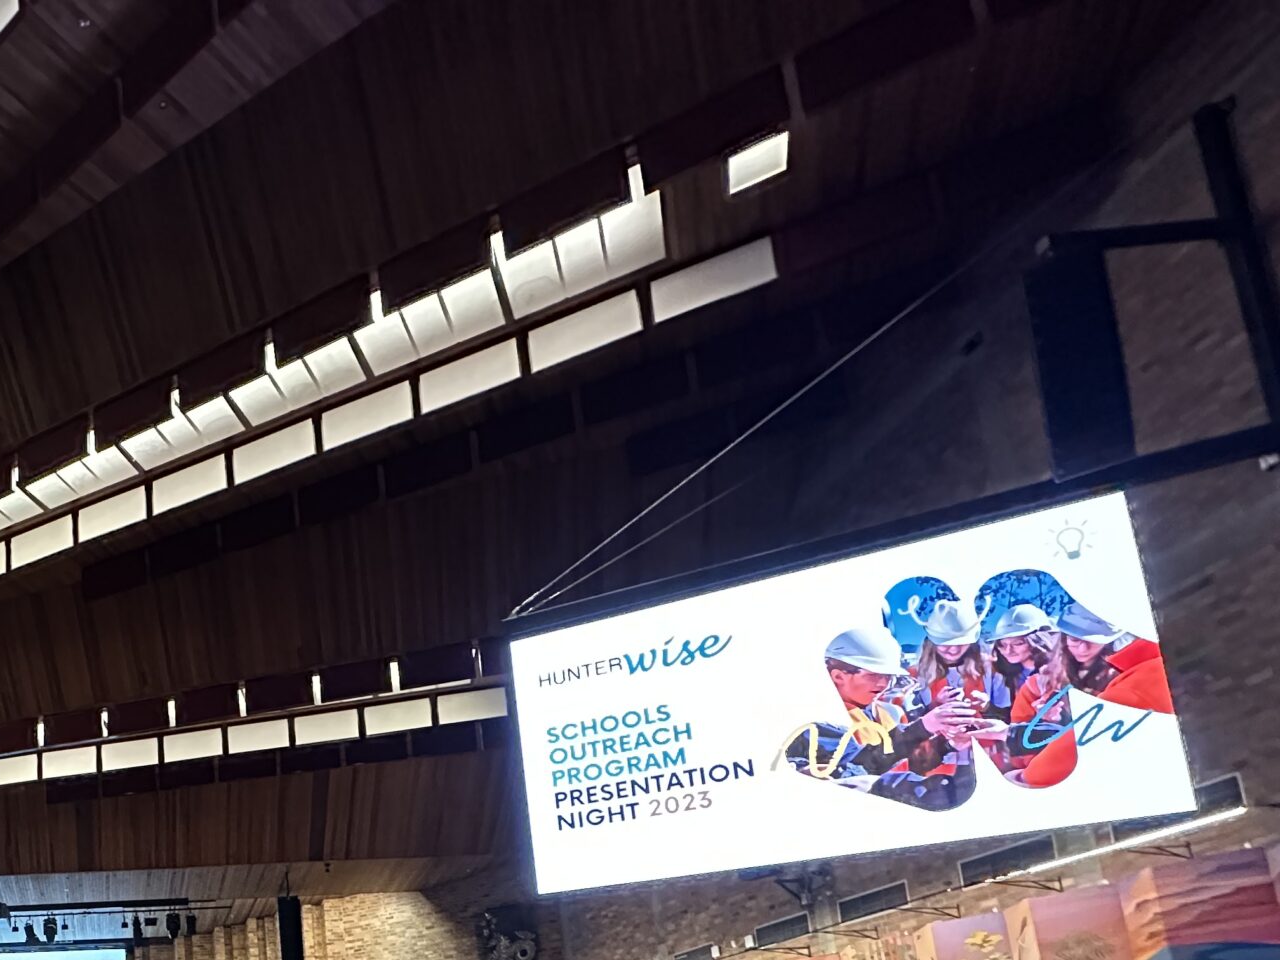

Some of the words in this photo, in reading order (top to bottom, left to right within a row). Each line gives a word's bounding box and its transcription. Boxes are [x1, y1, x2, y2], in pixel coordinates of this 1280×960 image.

[546, 704, 671, 743] SCHOOLS
[549, 722, 692, 764] OUTREACH
[552, 747, 686, 787] PROGRAM
[555, 759, 755, 809] PRESENTATION
[557, 802, 640, 831] NIGHT
[648, 790, 713, 817] 2023
